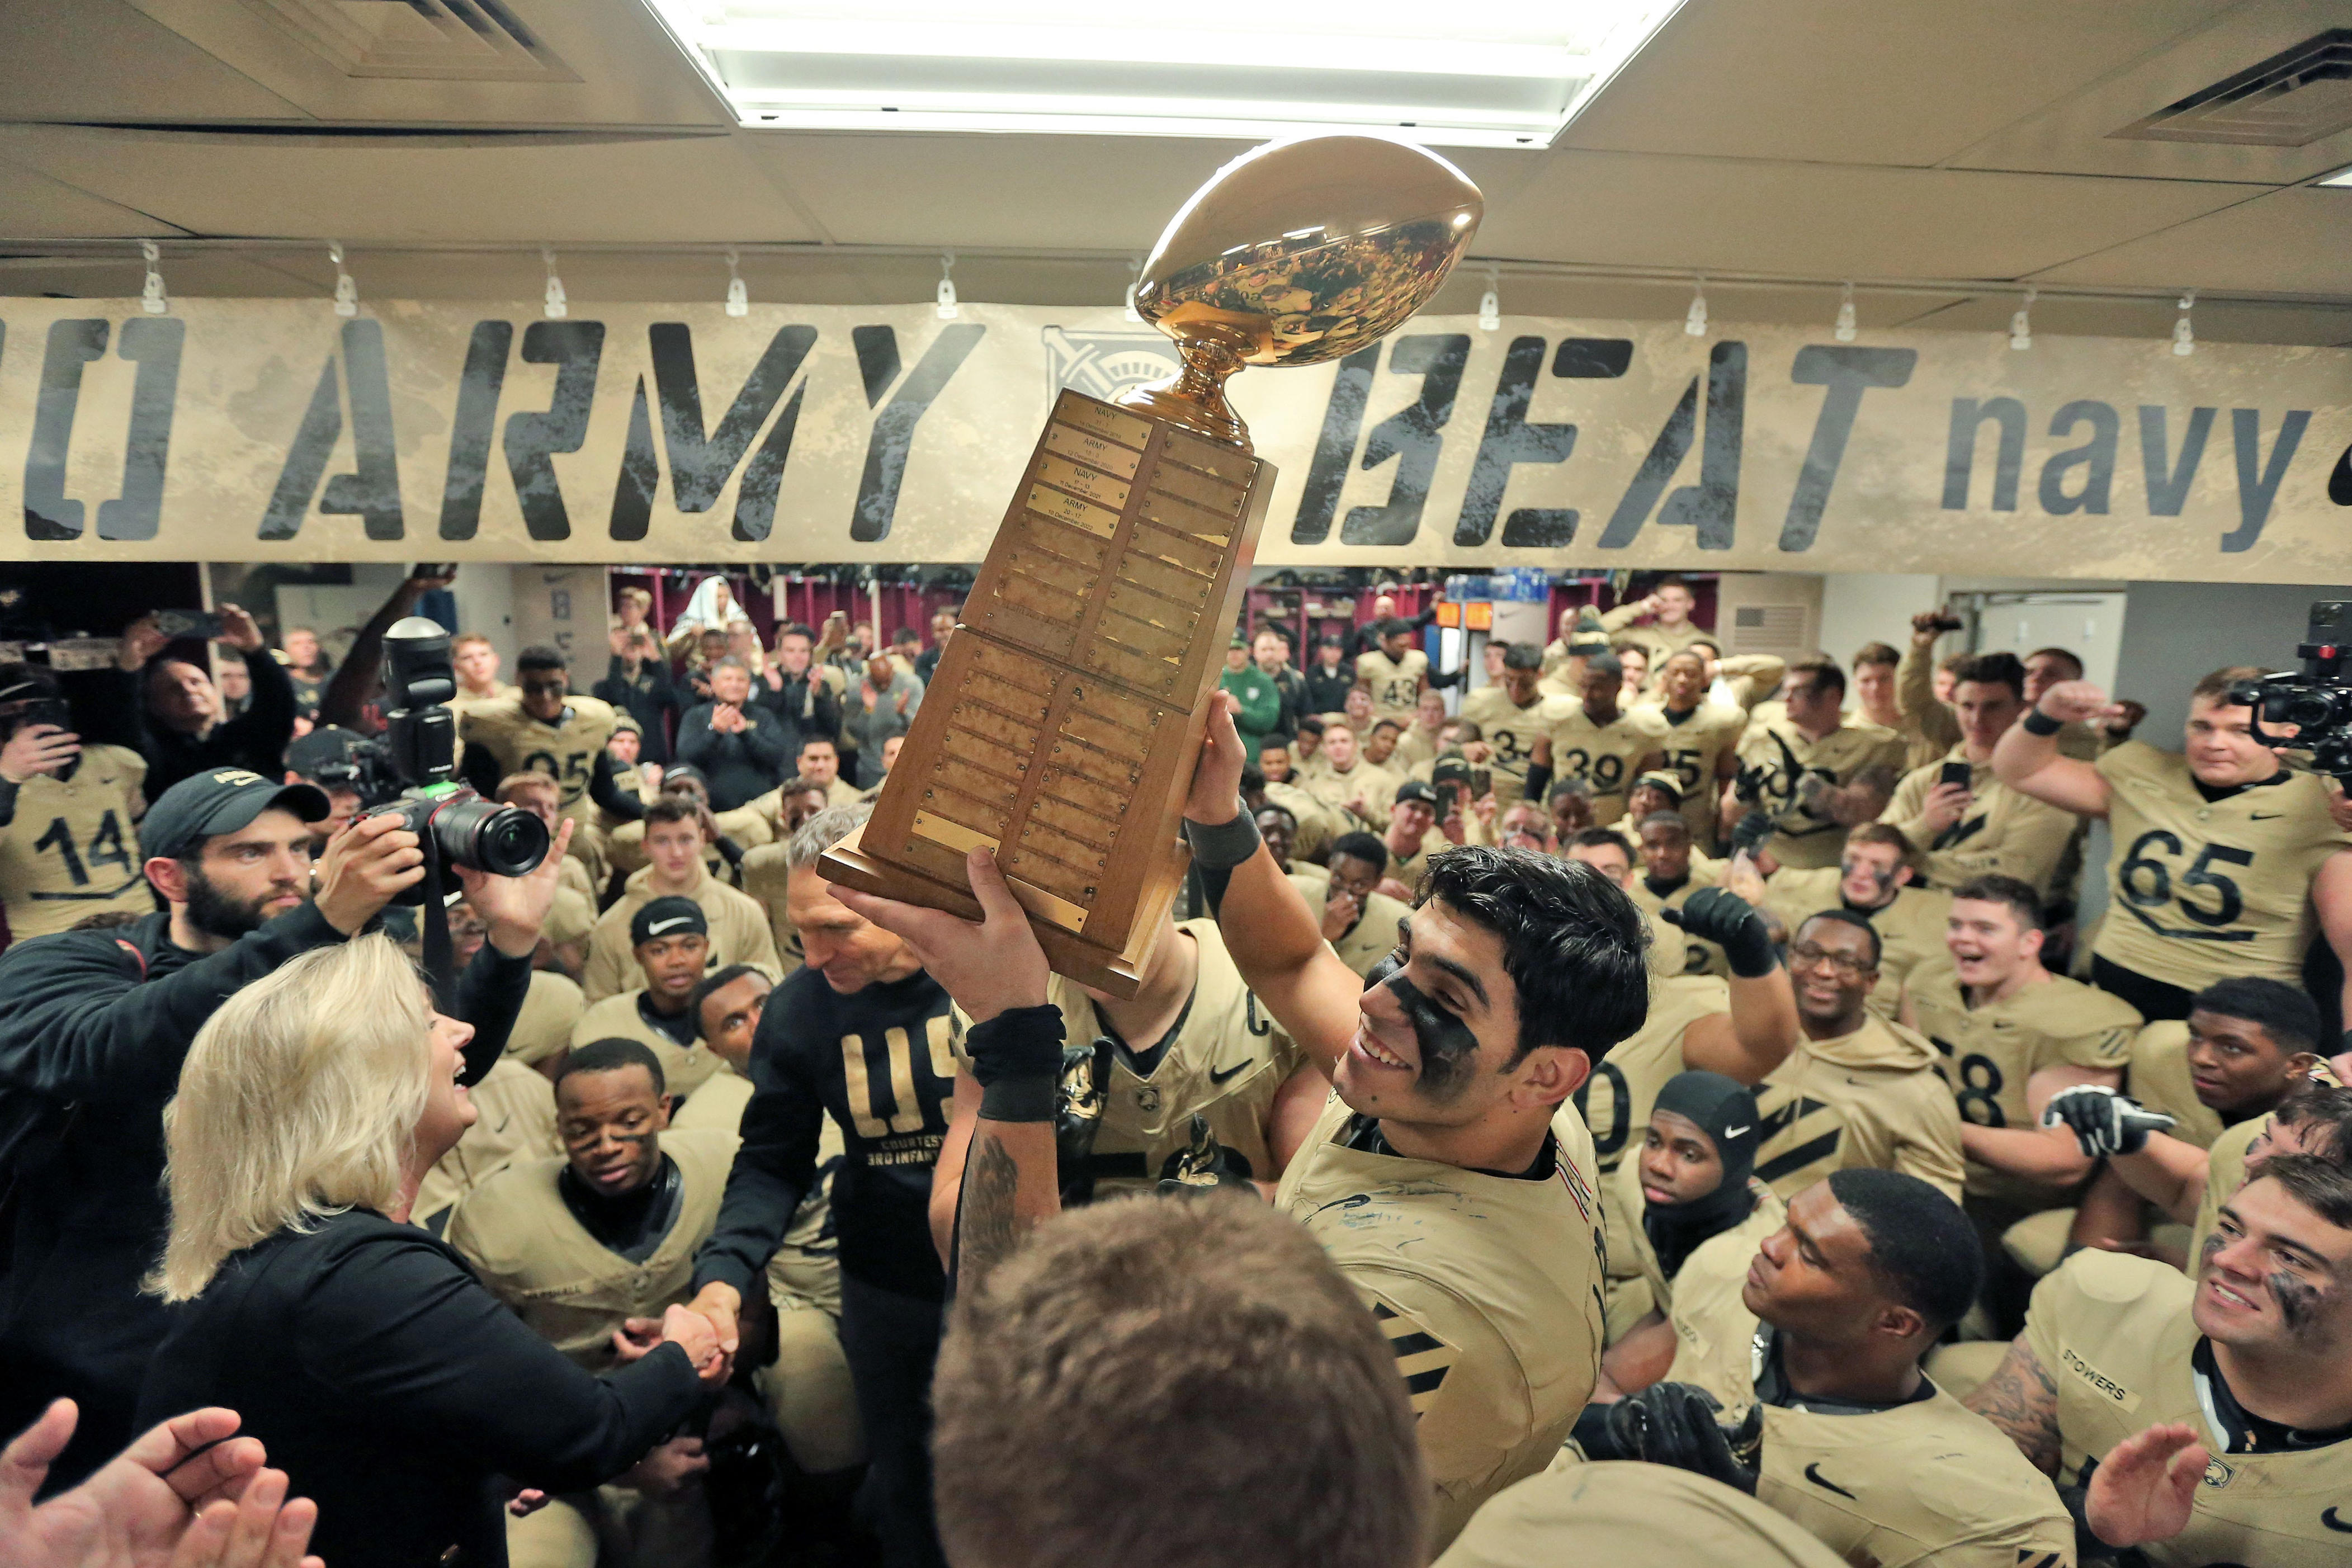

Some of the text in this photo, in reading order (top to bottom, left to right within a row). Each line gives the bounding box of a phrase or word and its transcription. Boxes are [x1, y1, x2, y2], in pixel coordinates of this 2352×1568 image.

[1095, 407, 1117, 419] NAVY
[0, 318, 2313, 552] O ARMY BEAT navy
[1083, 438, 1108, 451] ARMY
[1074, 467, 1098, 481] NAVY
[1065, 482, 1088, 494] December
[1063, 498, 1088, 512] ARMY
[1055, 512, 1079, 526] December
[1080, 521, 1093, 531] 2022
[34, 809, 131, 885] 14
[2120, 830, 2255, 926] 65
[2063, 1349, 2126, 1401] STOWERS
